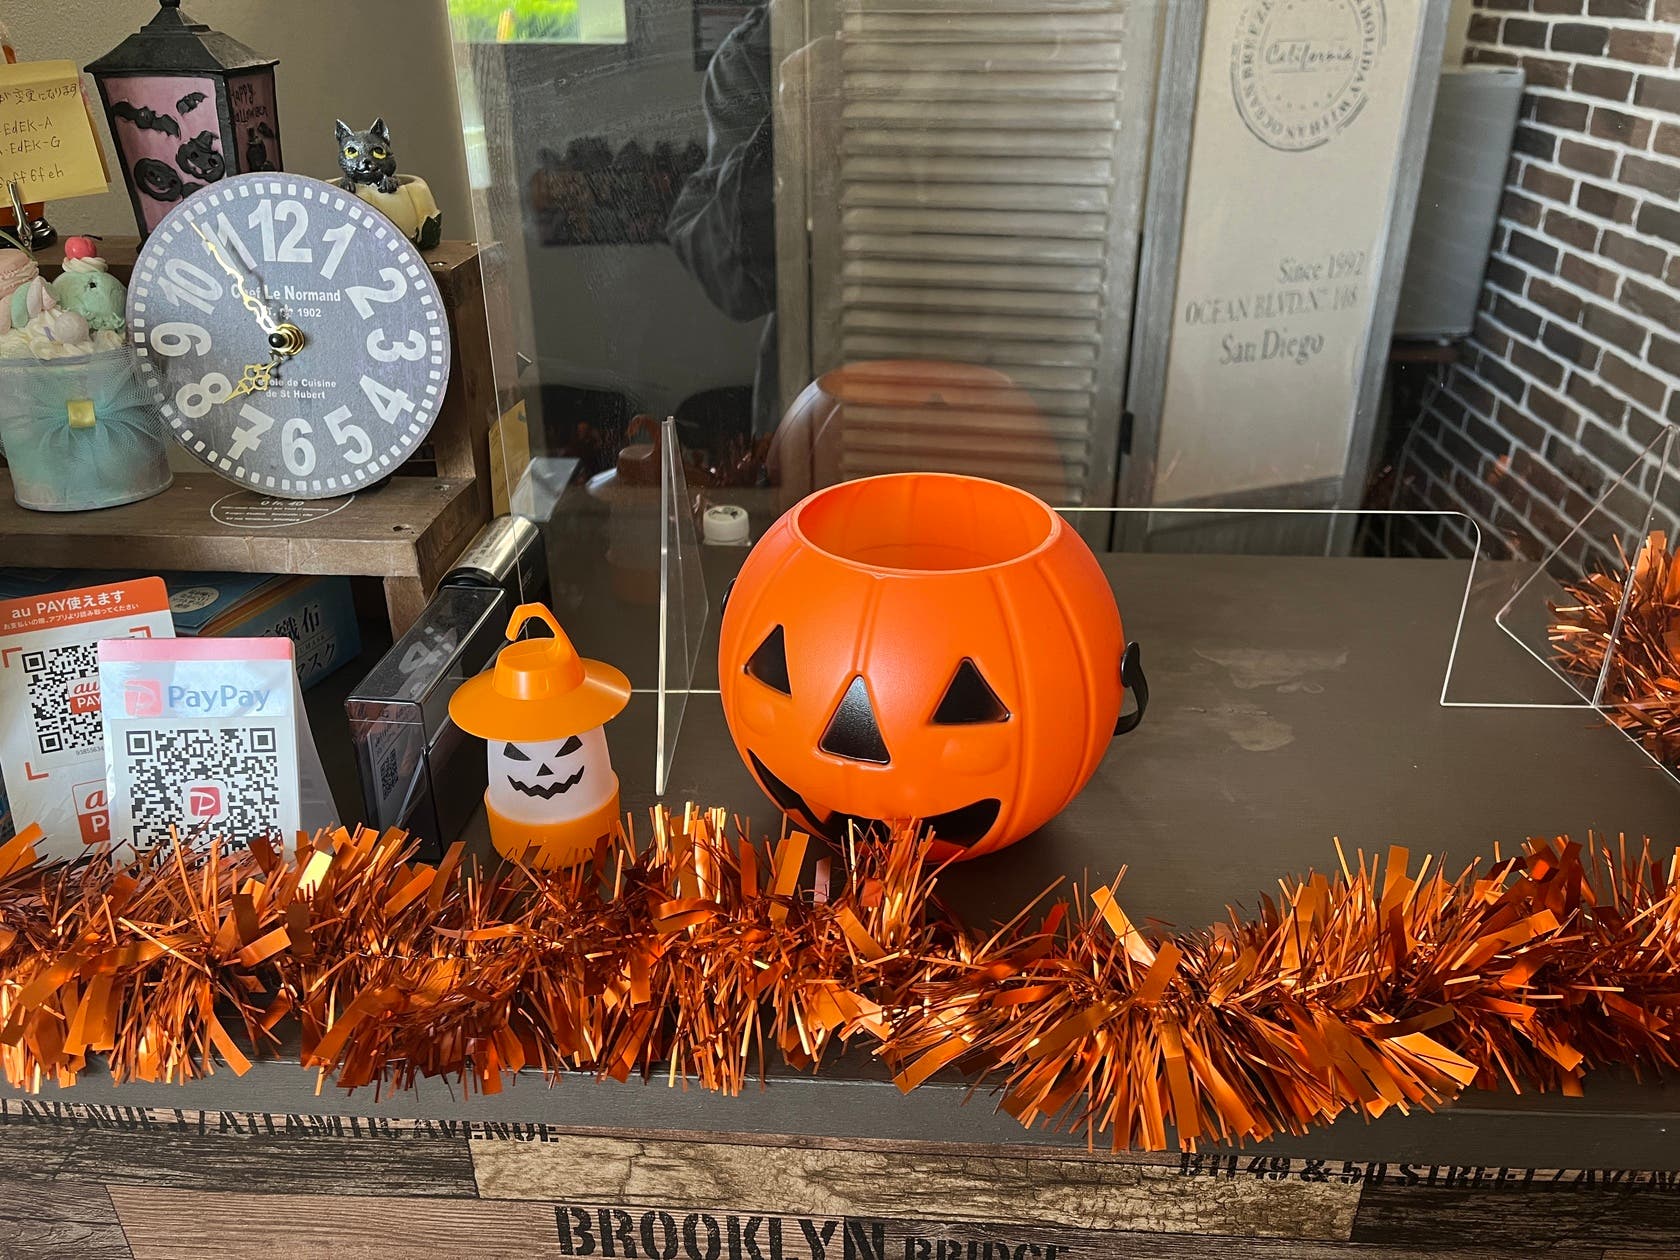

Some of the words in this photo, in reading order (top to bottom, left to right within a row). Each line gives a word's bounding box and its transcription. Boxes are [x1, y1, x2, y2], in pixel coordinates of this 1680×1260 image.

[249, 199, 313, 263] 12
[319, 222, 357, 280] 1
[157, 258, 223, 315] 10
[1277, 256, 1323, 283] Since
[230, 284, 261, 299] Cef
[264, 284, 280, 300] Le
[284, 285, 341, 302] Normand
[344, 267, 408, 320] 2
[297, 307, 322, 318] 1902
[150, 321, 212, 357] 9
[367, 328, 426, 362] 3
[1219, 333, 1257, 366] San
[1260, 327, 1325, 366] Diego
[175, 372, 233, 418] 8
[266, 389, 278, 398] de
[280, 389, 291, 399] St
[293, 389, 326, 400] Hubert
[287, 378, 299, 387] de
[301, 377, 337, 389] Cuisine
[359, 374, 417, 425] 4
[227, 403, 275, 460] 7
[281, 418, 316, 476] 6
[323, 405, 373, 465] 5
[12, 607, 31, 619] au
[73, 680, 100, 694] au
[76, 694, 102, 709] PAY
[167, 684, 271, 712] PayPay
[85, 789, 109, 810] a
[1247, 1155, 1291, 1181] 49
[1301, 1158, 1332, 1183] &
[1341, 1160, 1389, 1185] 50
[554, 1205, 885, 1260] BROOKLYN
